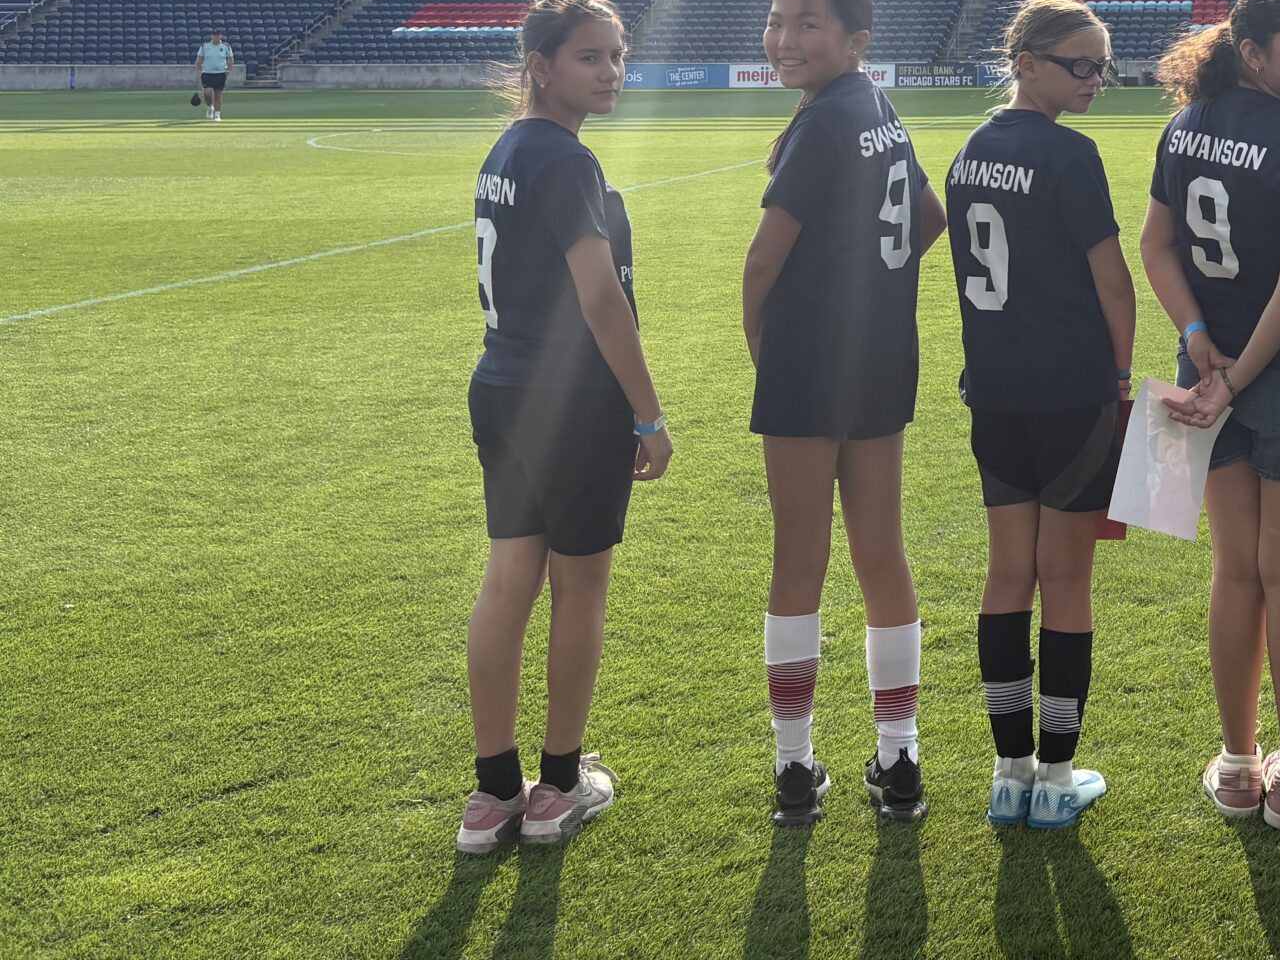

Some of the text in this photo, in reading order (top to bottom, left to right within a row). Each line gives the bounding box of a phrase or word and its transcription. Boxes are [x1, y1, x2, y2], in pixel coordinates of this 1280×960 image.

[670, 71, 705, 81] THE CENTER
[737, 66, 779, 85] meije
[898, 65, 931, 76] OFFICIAL
[933, 65, 955, 75] BANK
[898, 76, 973, 86] CHICAGO STARS FC
[1168, 129, 1267, 171] SWANSON
[950, 159, 1034, 194] SWANSON
[878, 159, 912, 270] 9
[1186, 175, 1240, 279] 9
[964, 202, 1010, 311] 9
